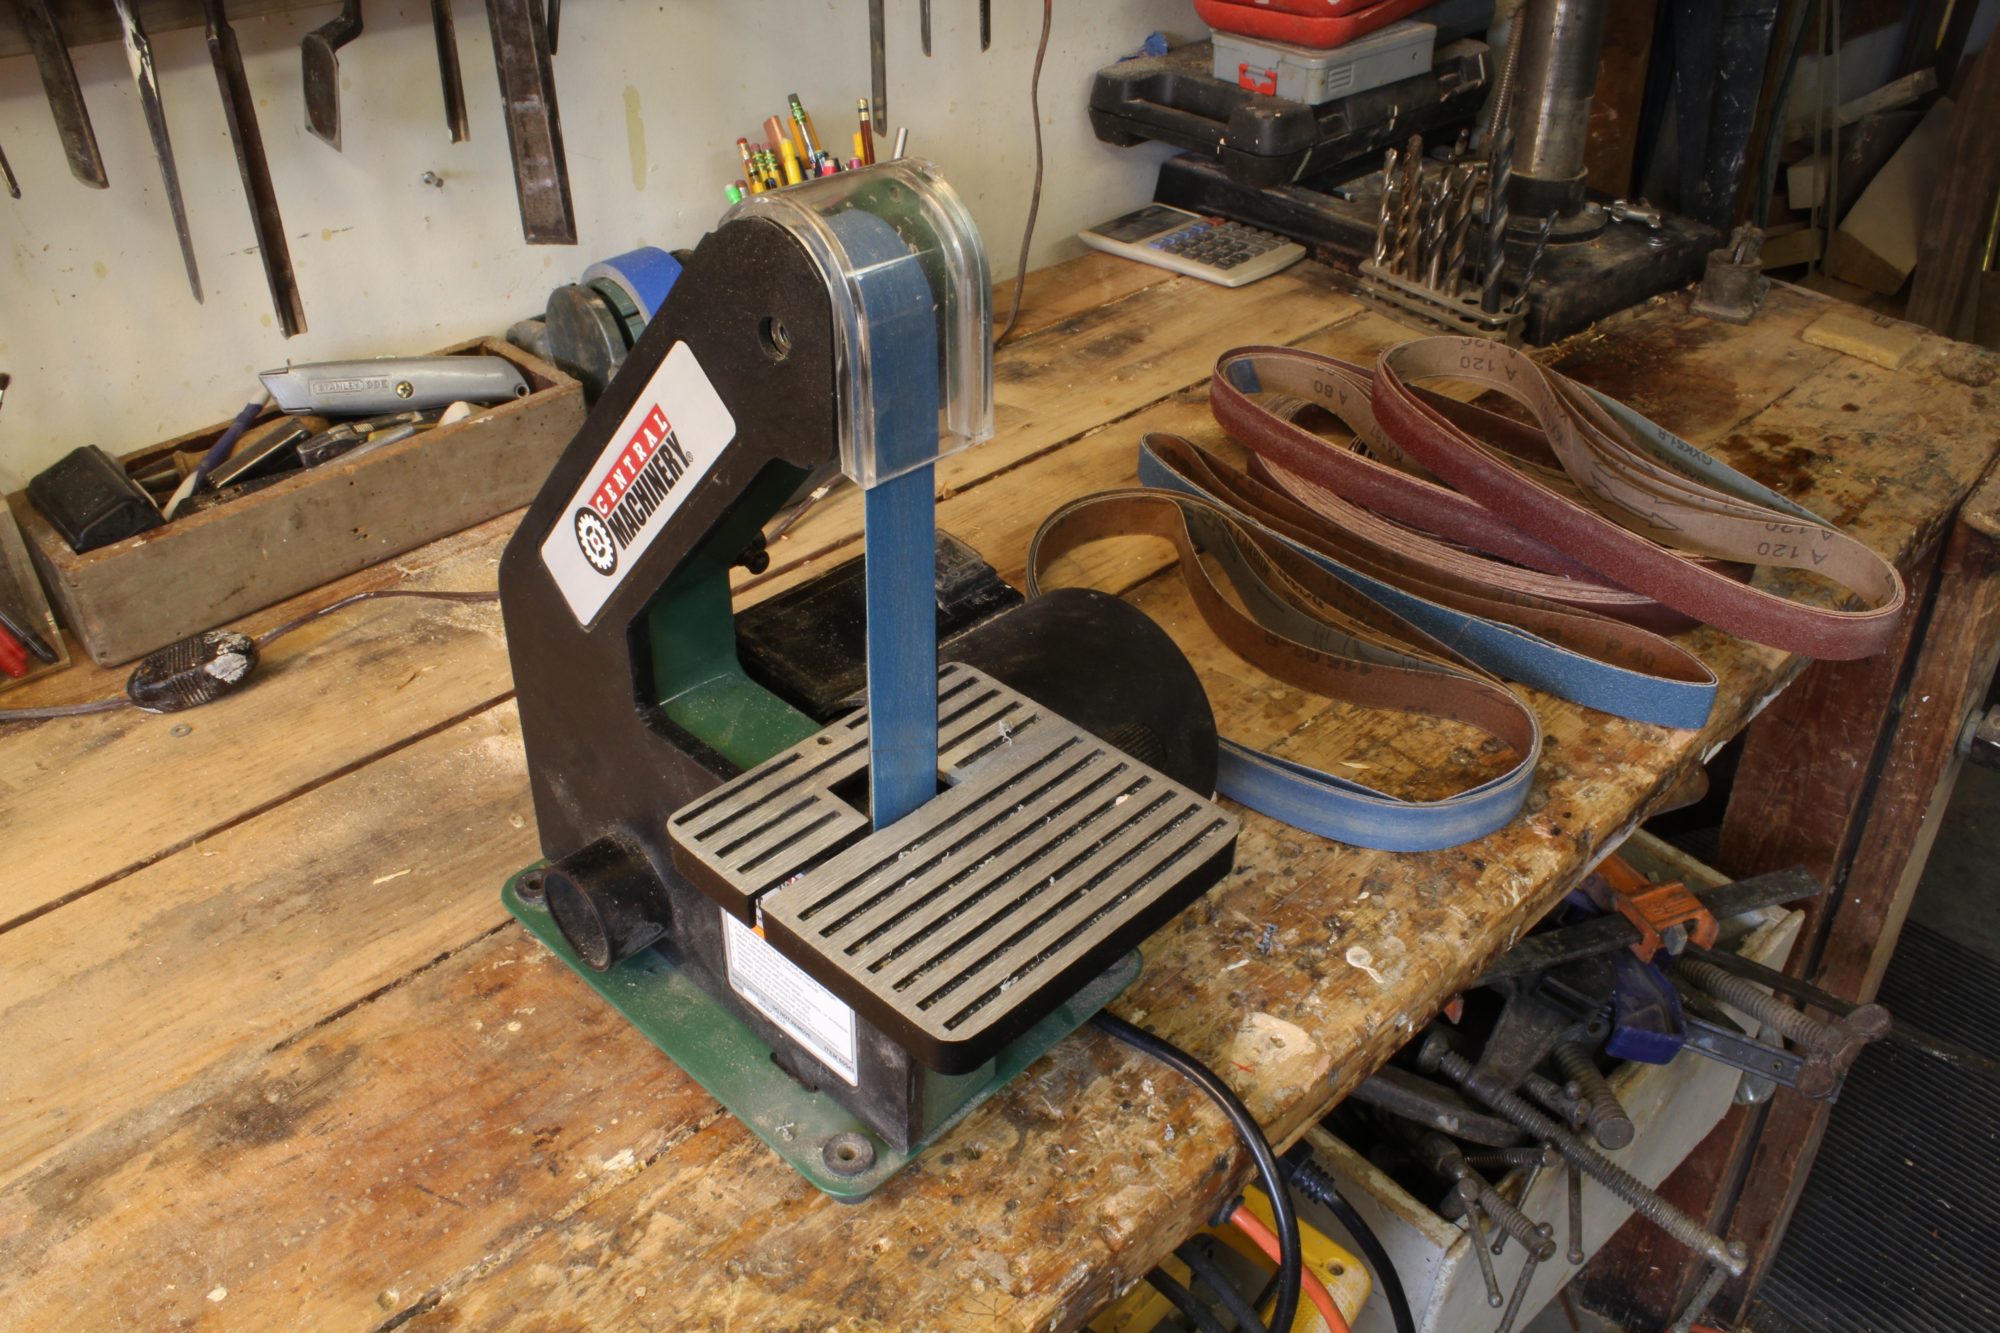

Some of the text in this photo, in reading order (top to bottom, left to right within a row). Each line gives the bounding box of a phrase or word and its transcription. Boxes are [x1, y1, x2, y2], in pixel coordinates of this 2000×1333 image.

[1460, 355, 1517, 381] A 120
[317, 381, 362, 393] STANLEY
[1314, 379, 1348, 406] A 80
[595, 412, 668, 515] CENTRAL
[608, 431, 690, 550] MACHINERY
[1757, 541, 1828, 565] A 120
